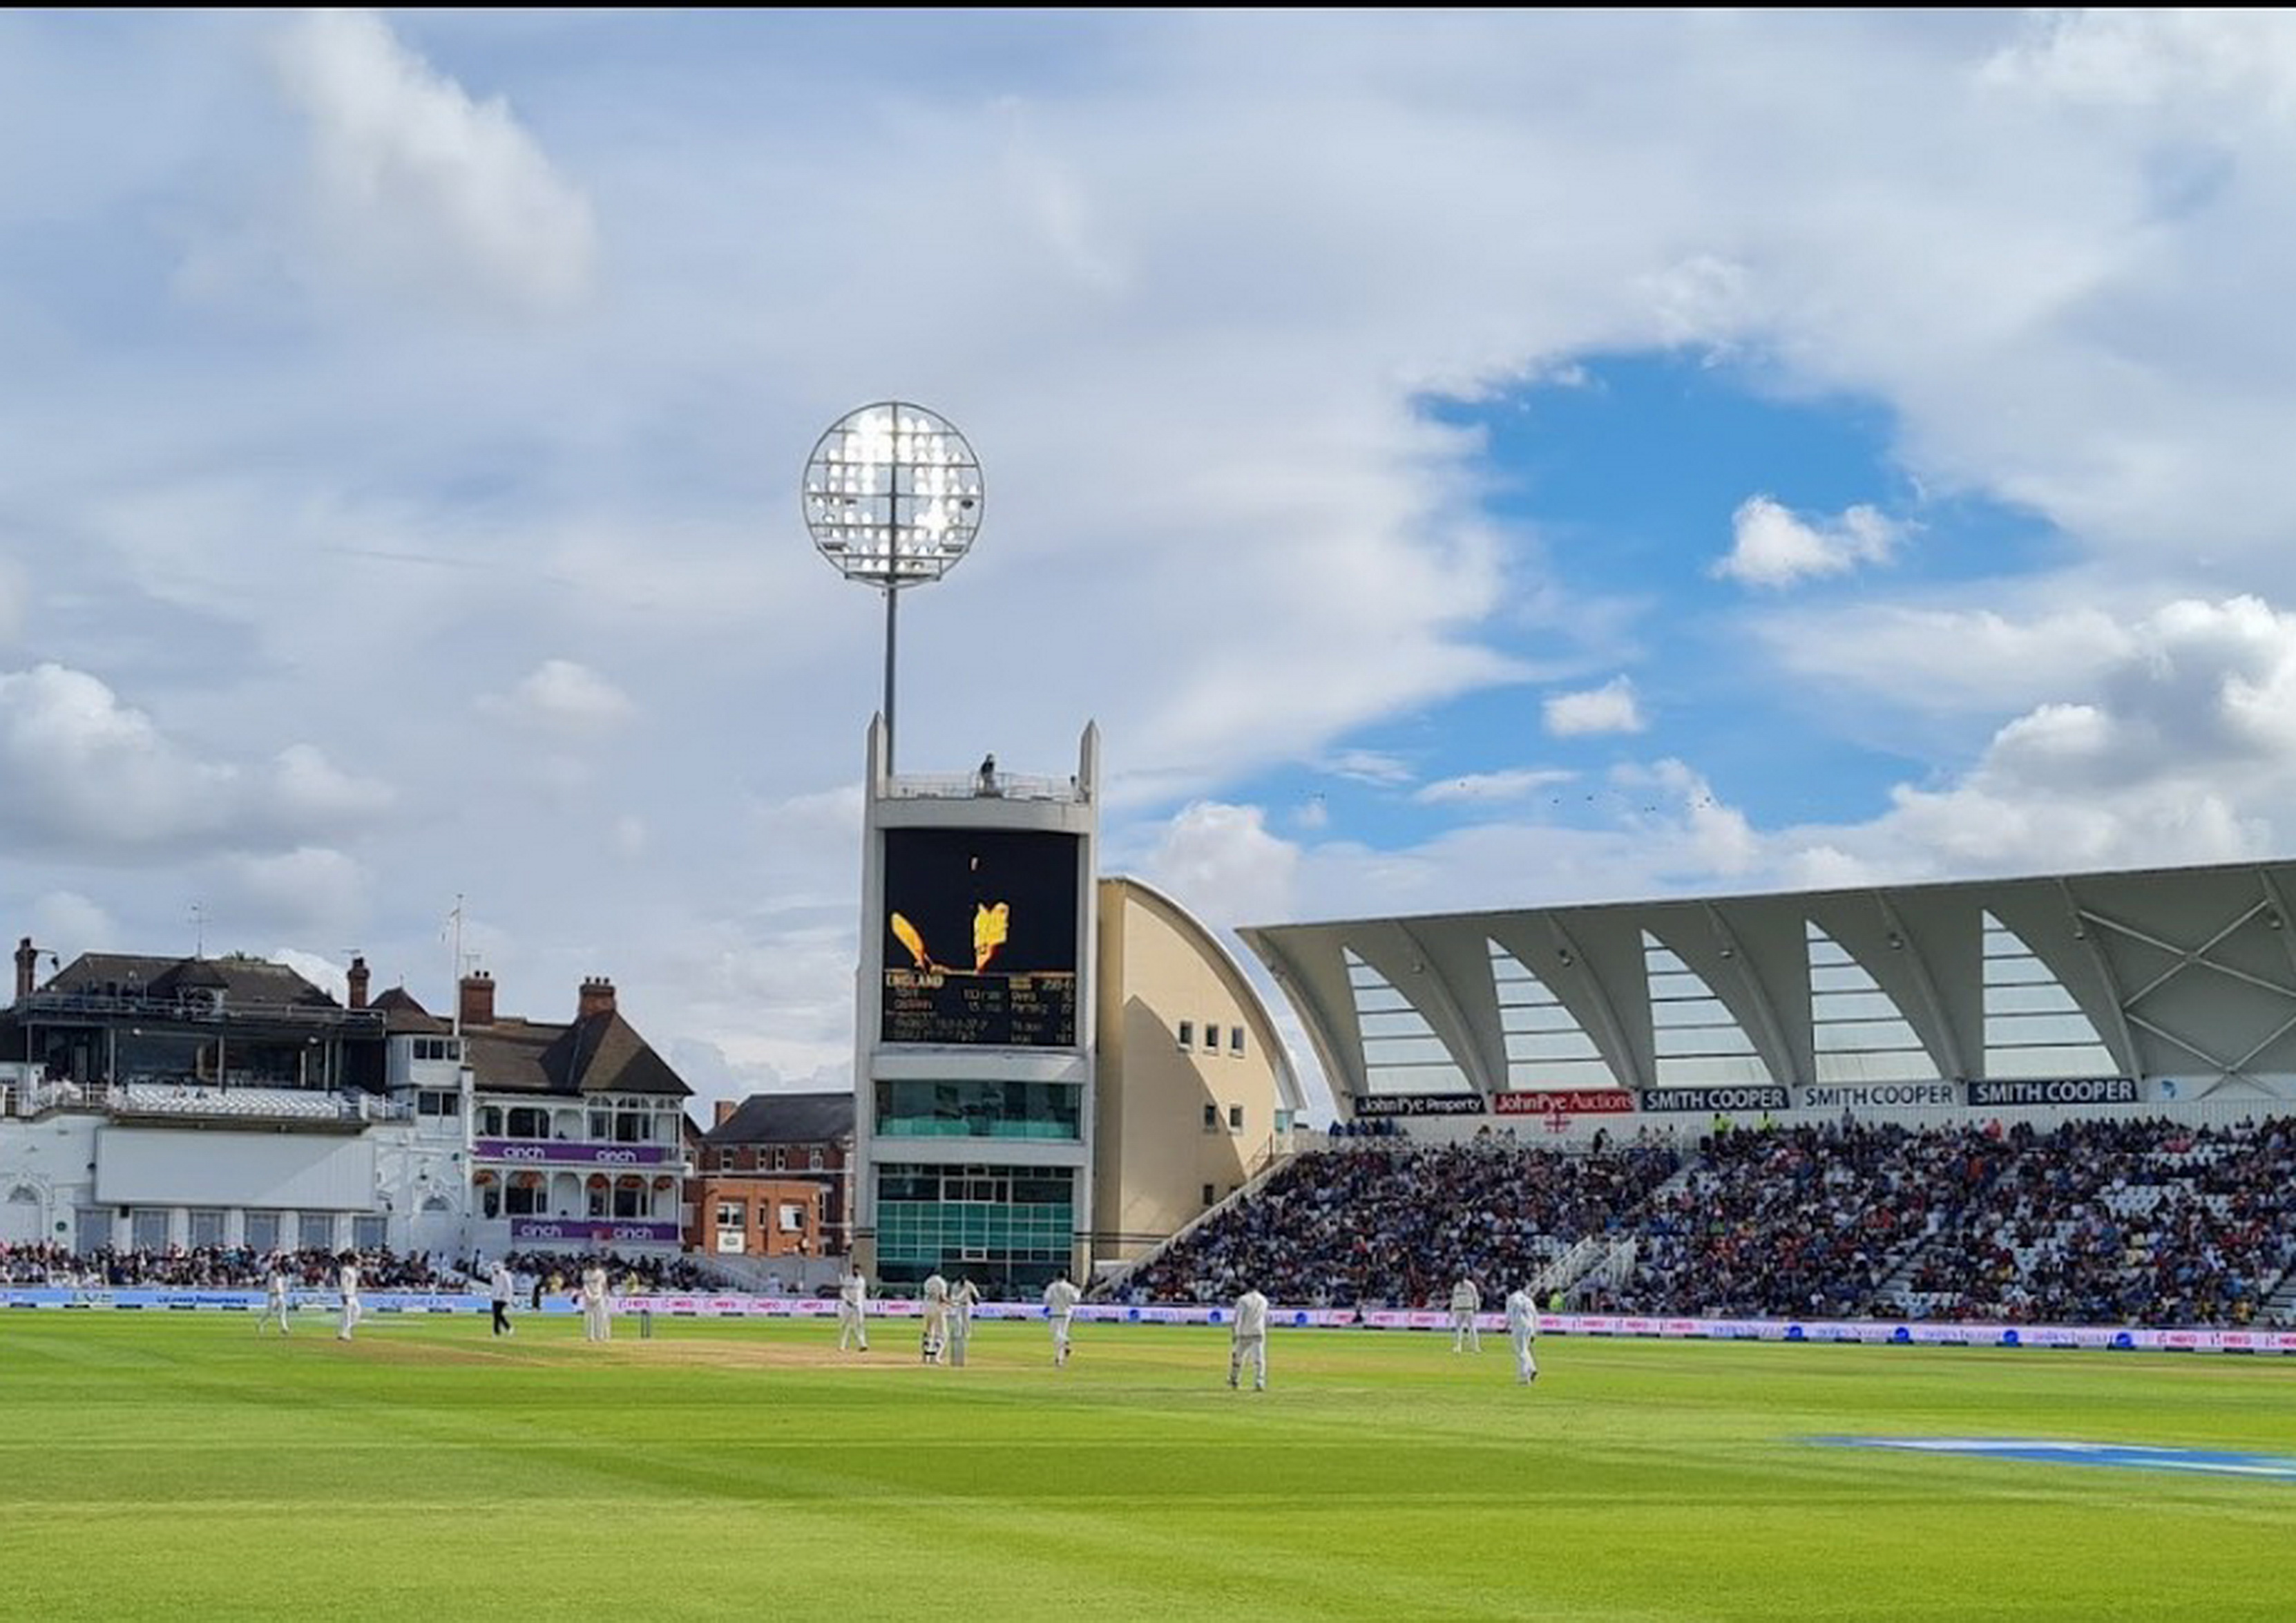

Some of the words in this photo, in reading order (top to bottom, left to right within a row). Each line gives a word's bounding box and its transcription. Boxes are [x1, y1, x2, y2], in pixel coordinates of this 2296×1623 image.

[1647, 1090, 1704, 1110] SMITH
[1707, 1088, 1784, 1108] COOPER
[1805, 1087, 1868, 1106] SMITH
[1871, 1085, 1953, 1104] COOPER
[1977, 1083, 2043, 1103] SMITH
[2046, 1081, 2133, 1102] COOPER
[503, 1146, 546, 1159] cinch
[595, 1150, 637, 1162] cinch
[521, 1224, 562, 1238] cinch
[612, 1226, 653, 1239] cinch
